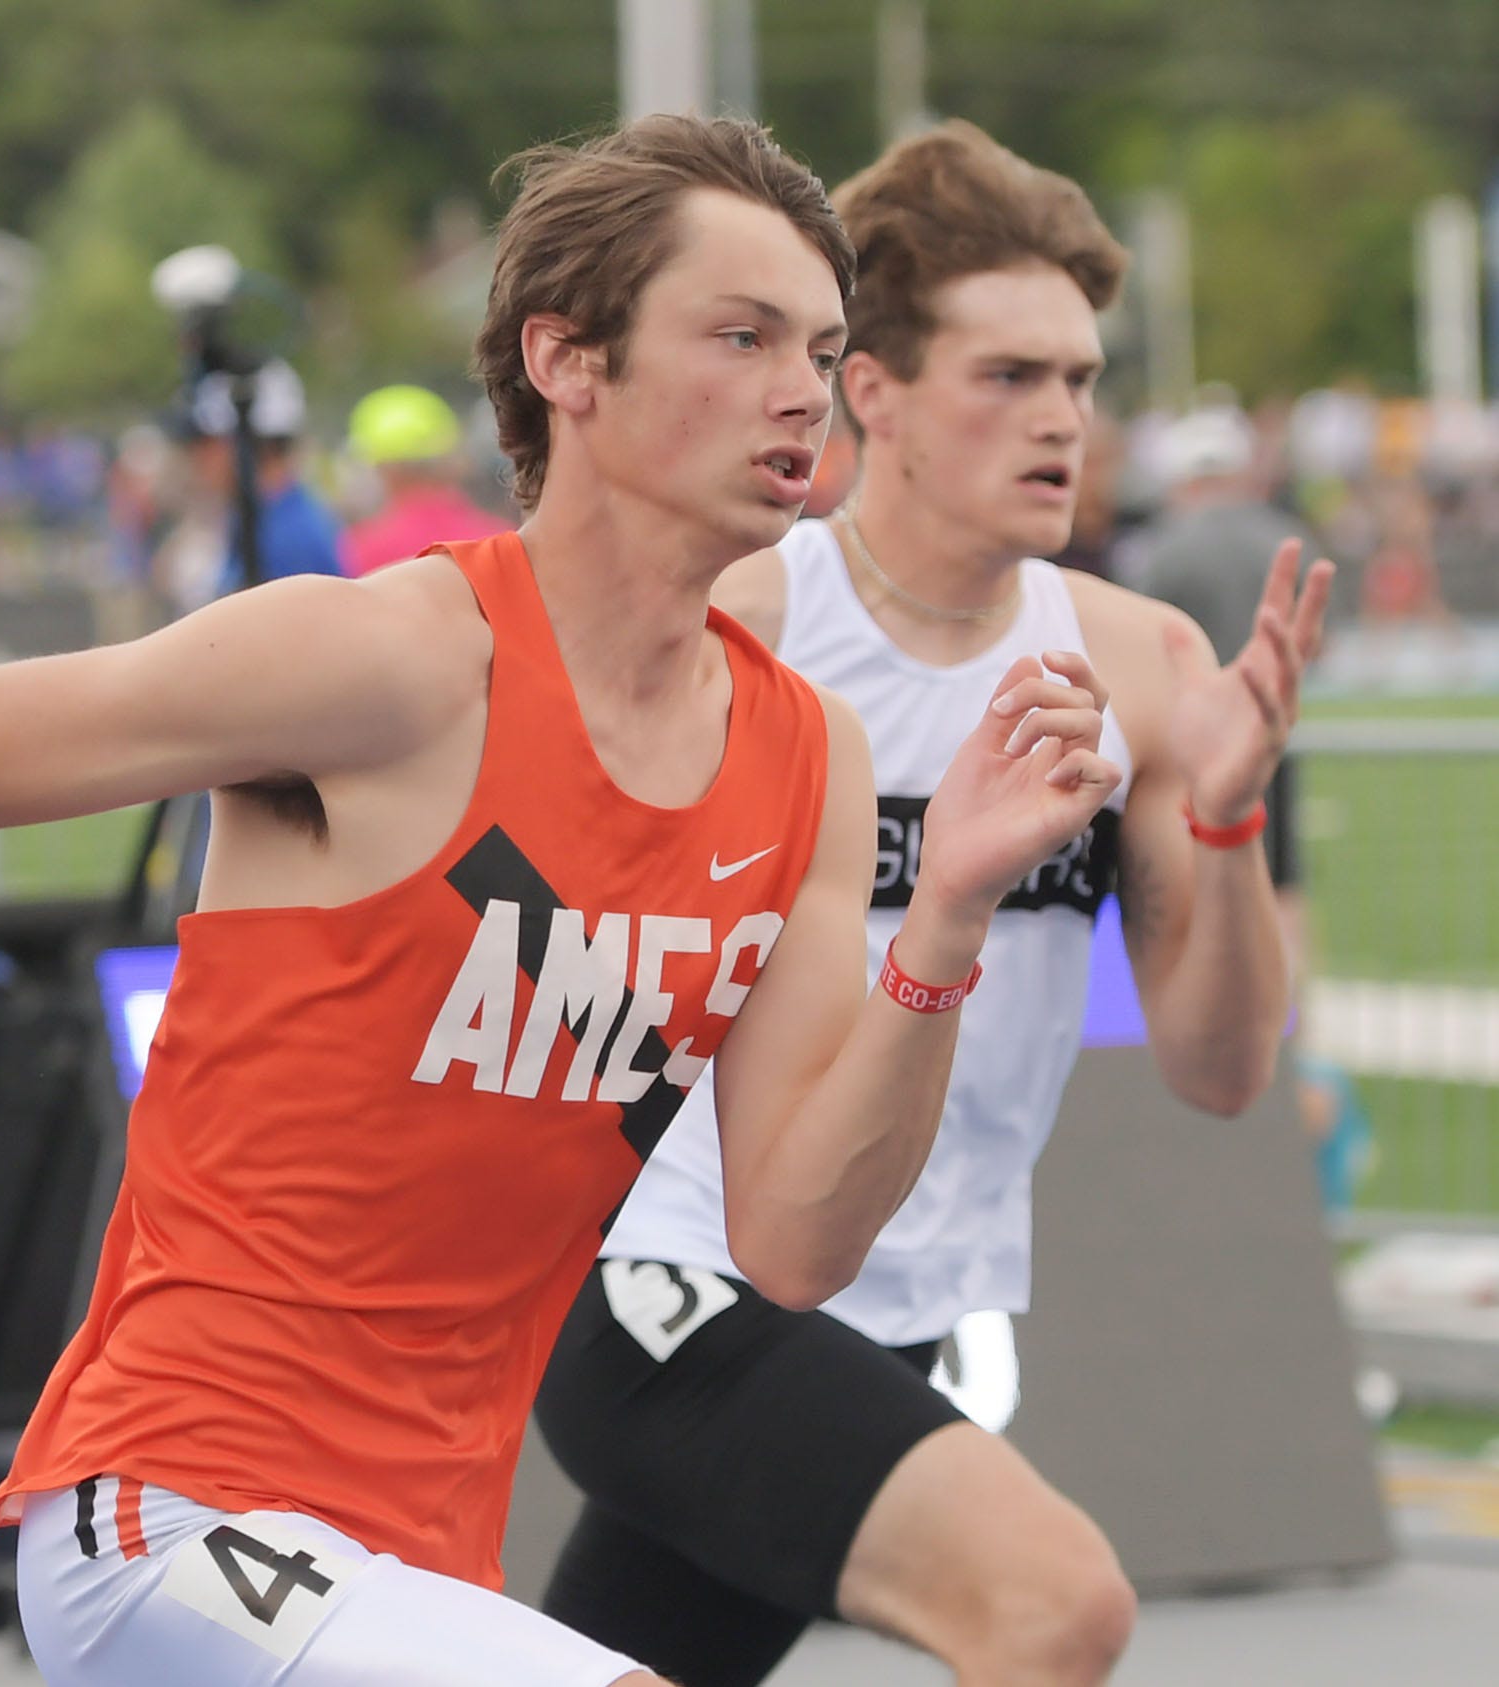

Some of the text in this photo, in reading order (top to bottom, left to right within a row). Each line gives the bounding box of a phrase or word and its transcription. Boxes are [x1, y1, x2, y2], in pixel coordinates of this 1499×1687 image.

[410, 898, 785, 1103] AMES
[898, 981, 964, 1010] CO-ED
[630, 1261, 698, 1334] 3
[203, 1525, 334, 1626] 4
